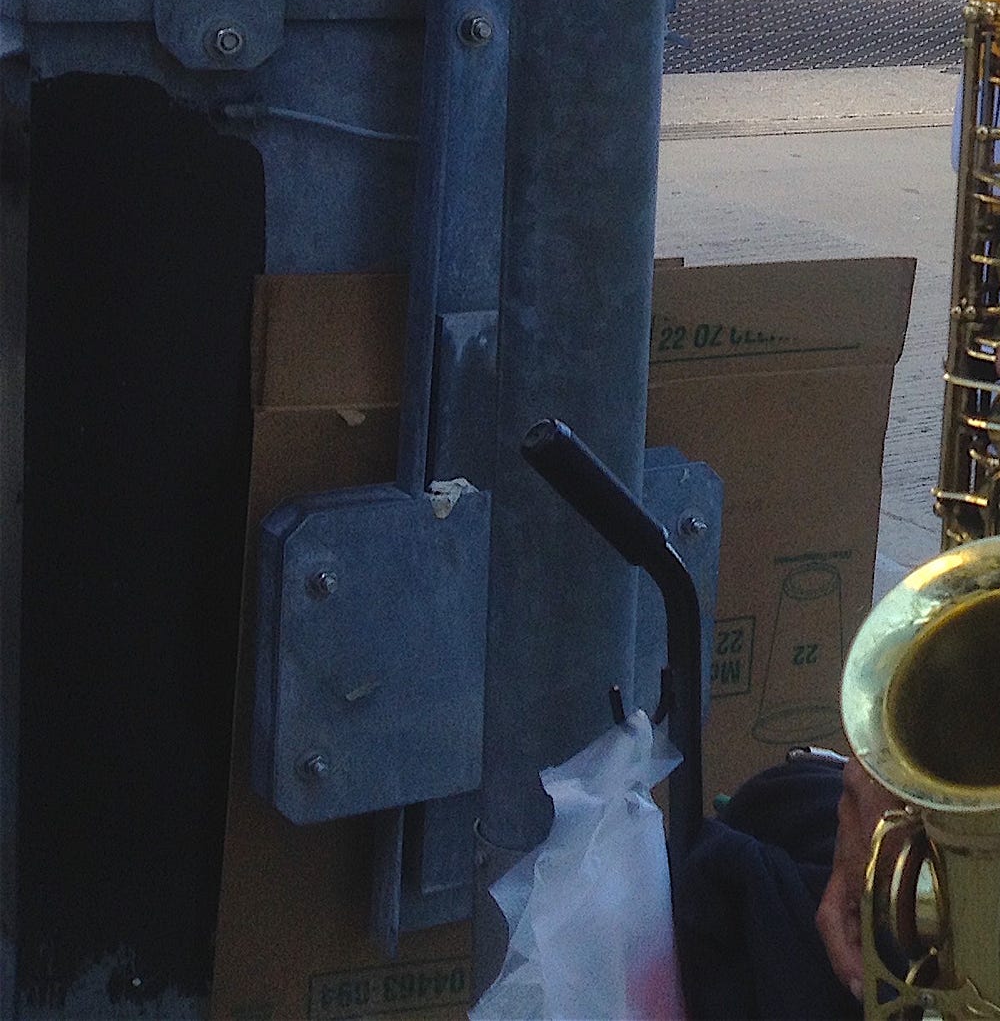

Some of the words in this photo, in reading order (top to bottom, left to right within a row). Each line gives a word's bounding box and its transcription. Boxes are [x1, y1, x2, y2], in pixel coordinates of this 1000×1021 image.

[659, 326, 687, 351] 22
[717, 630, 744, 655] 22
[792, 644, 818, 666] 22
